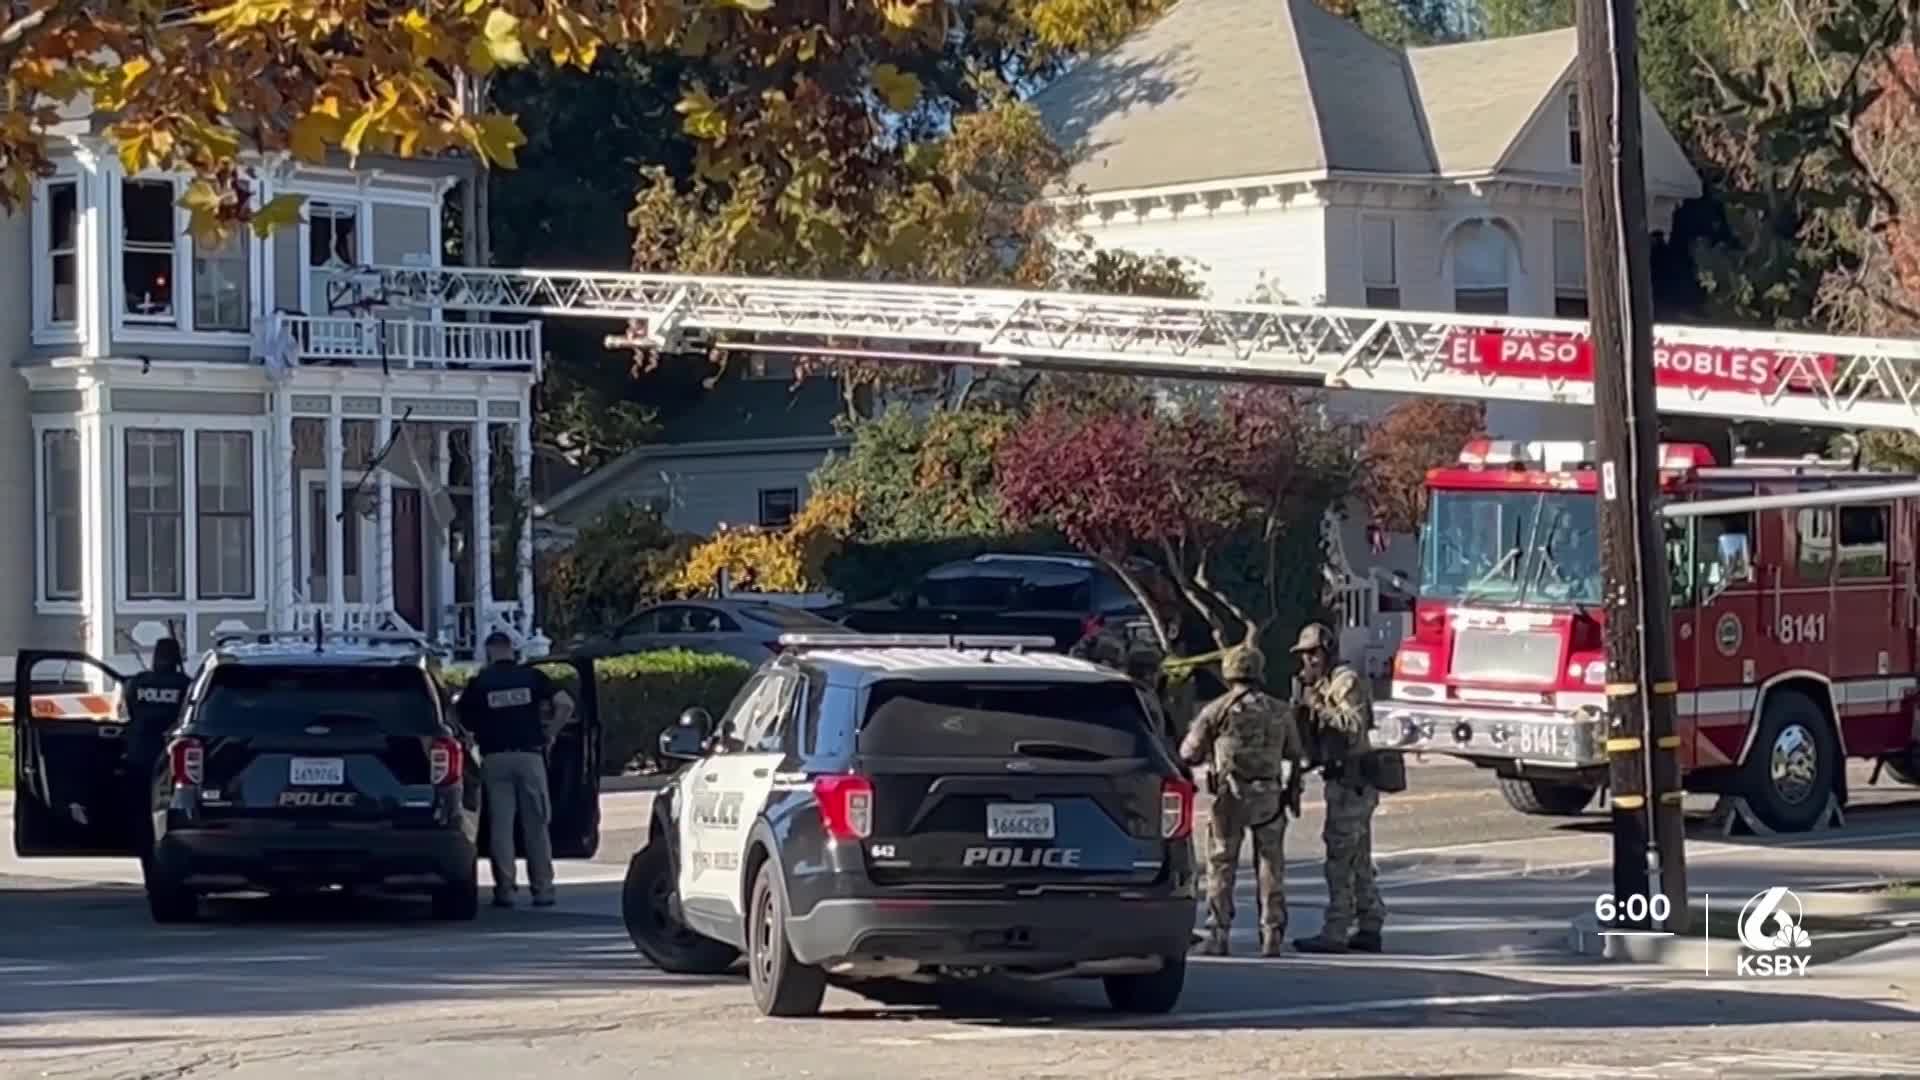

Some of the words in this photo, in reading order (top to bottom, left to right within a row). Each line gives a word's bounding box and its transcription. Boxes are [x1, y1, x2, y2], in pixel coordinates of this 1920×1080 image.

[1453, 338, 1483, 364] EL
[1502, 340, 1578, 363] PASO
[1654, 349, 1768, 384] ROBLES
[1781, 614, 1825, 644] 8141
[137, 688, 180, 702] POLICE
[1521, 724, 1557, 755] 8141
[279, 792, 359, 807] POLICE
[872, 845, 895, 857] 642
[963, 847, 1081, 867] POLICE
